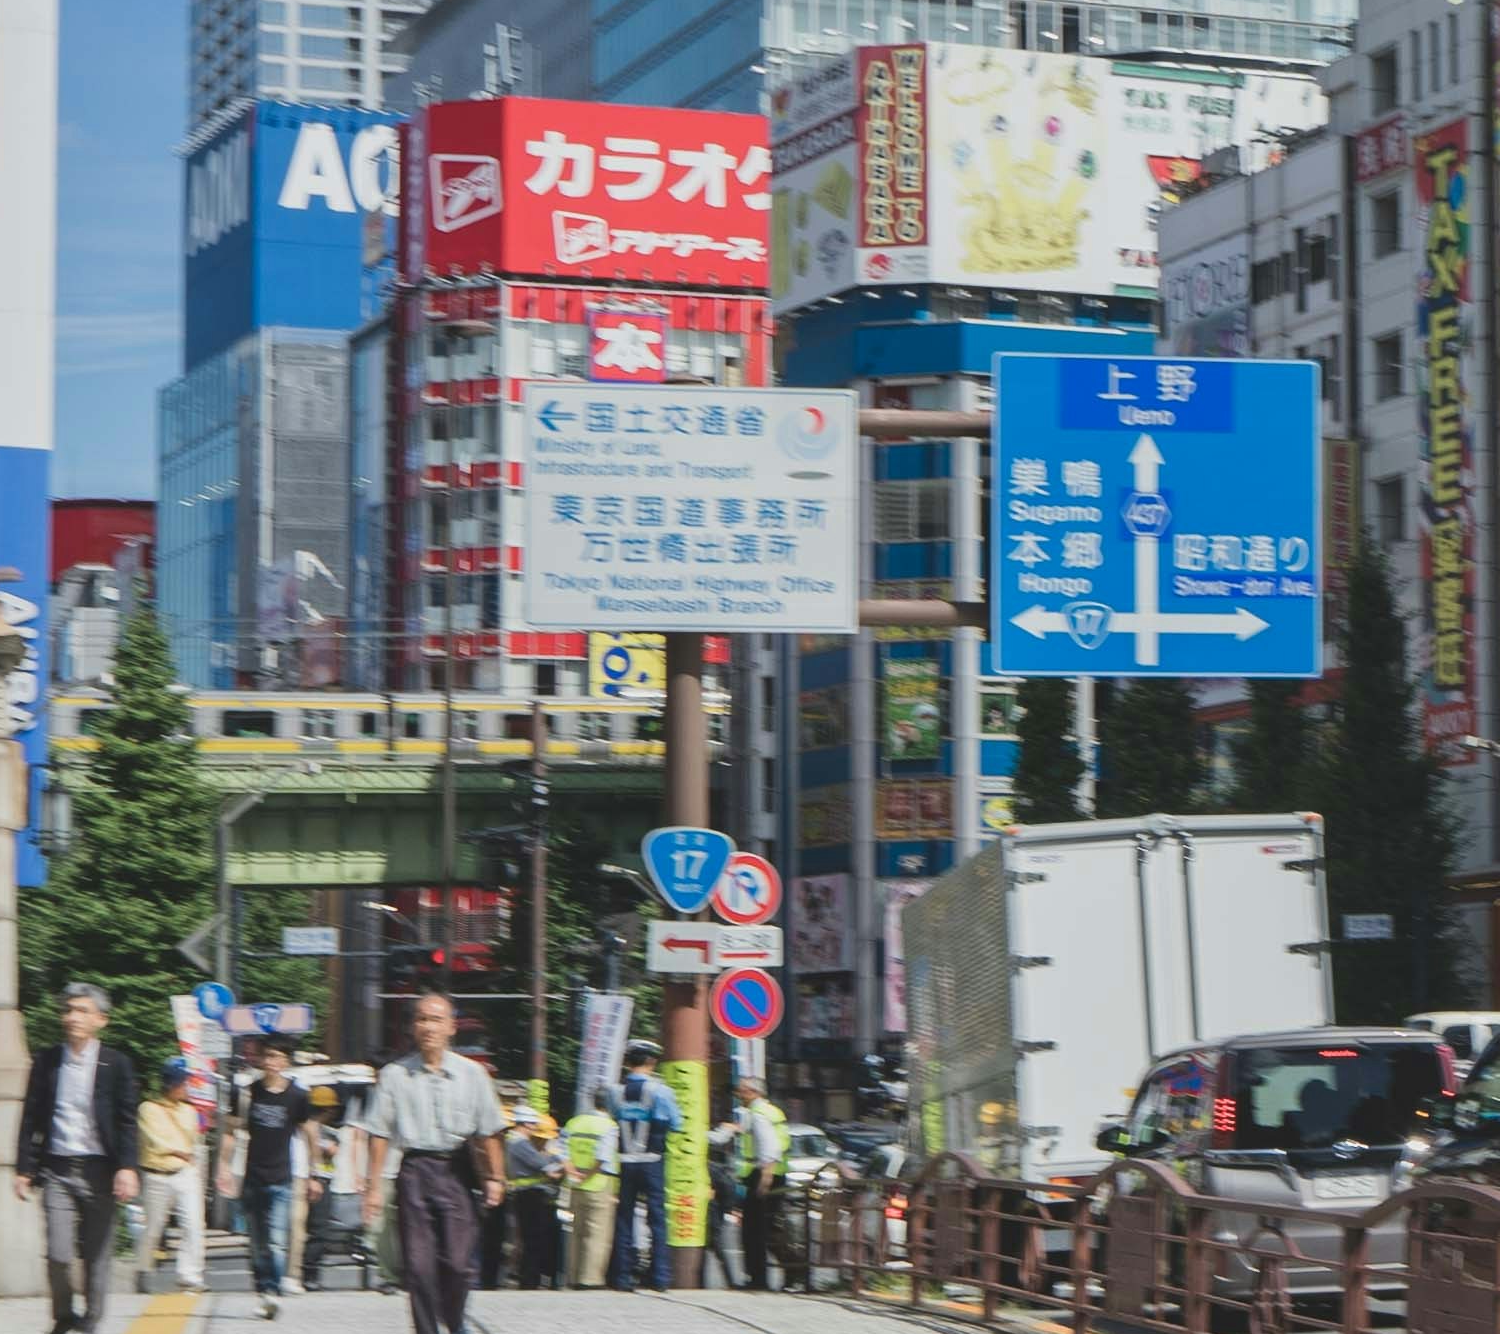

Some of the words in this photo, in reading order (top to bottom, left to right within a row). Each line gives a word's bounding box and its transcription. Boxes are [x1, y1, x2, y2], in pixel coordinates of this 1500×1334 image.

[891, 49, 926, 193] WELCOME
[862, 62, 897, 246] AKIHABARA
[894, 197, 925, 243] TO
[1426, 143, 1460, 298] TAX
[594, 323, 663, 373] 本
[1097, 363, 1197, 402] 上野
[584, 402, 767, 436] 国土交通省
[1118, 405, 1177, 425] Ueno
[1429, 306, 1462, 506] FREE
[645, 463, 674, 478] and
[1009, 458, 1103, 498] 巣鴨
[551, 495, 828, 529] 東京国道事務所
[1009, 500, 1103, 524] Sugamo
[580, 533, 797, 564] 万世橋出張所
[1007, 531, 1103, 568] 本郷
[1173, 534, 1310, 571] 昭和通り
[544, 572, 601, 592] Tokyo
[608, 573, 683, 590] National
[694, 574, 768, 594] Highway
[776, 575, 836, 593] Office
[1018, 573, 1093, 596] Hongo
[718, 597, 784, 614] Branch
[669, 851, 709, 880] 17
